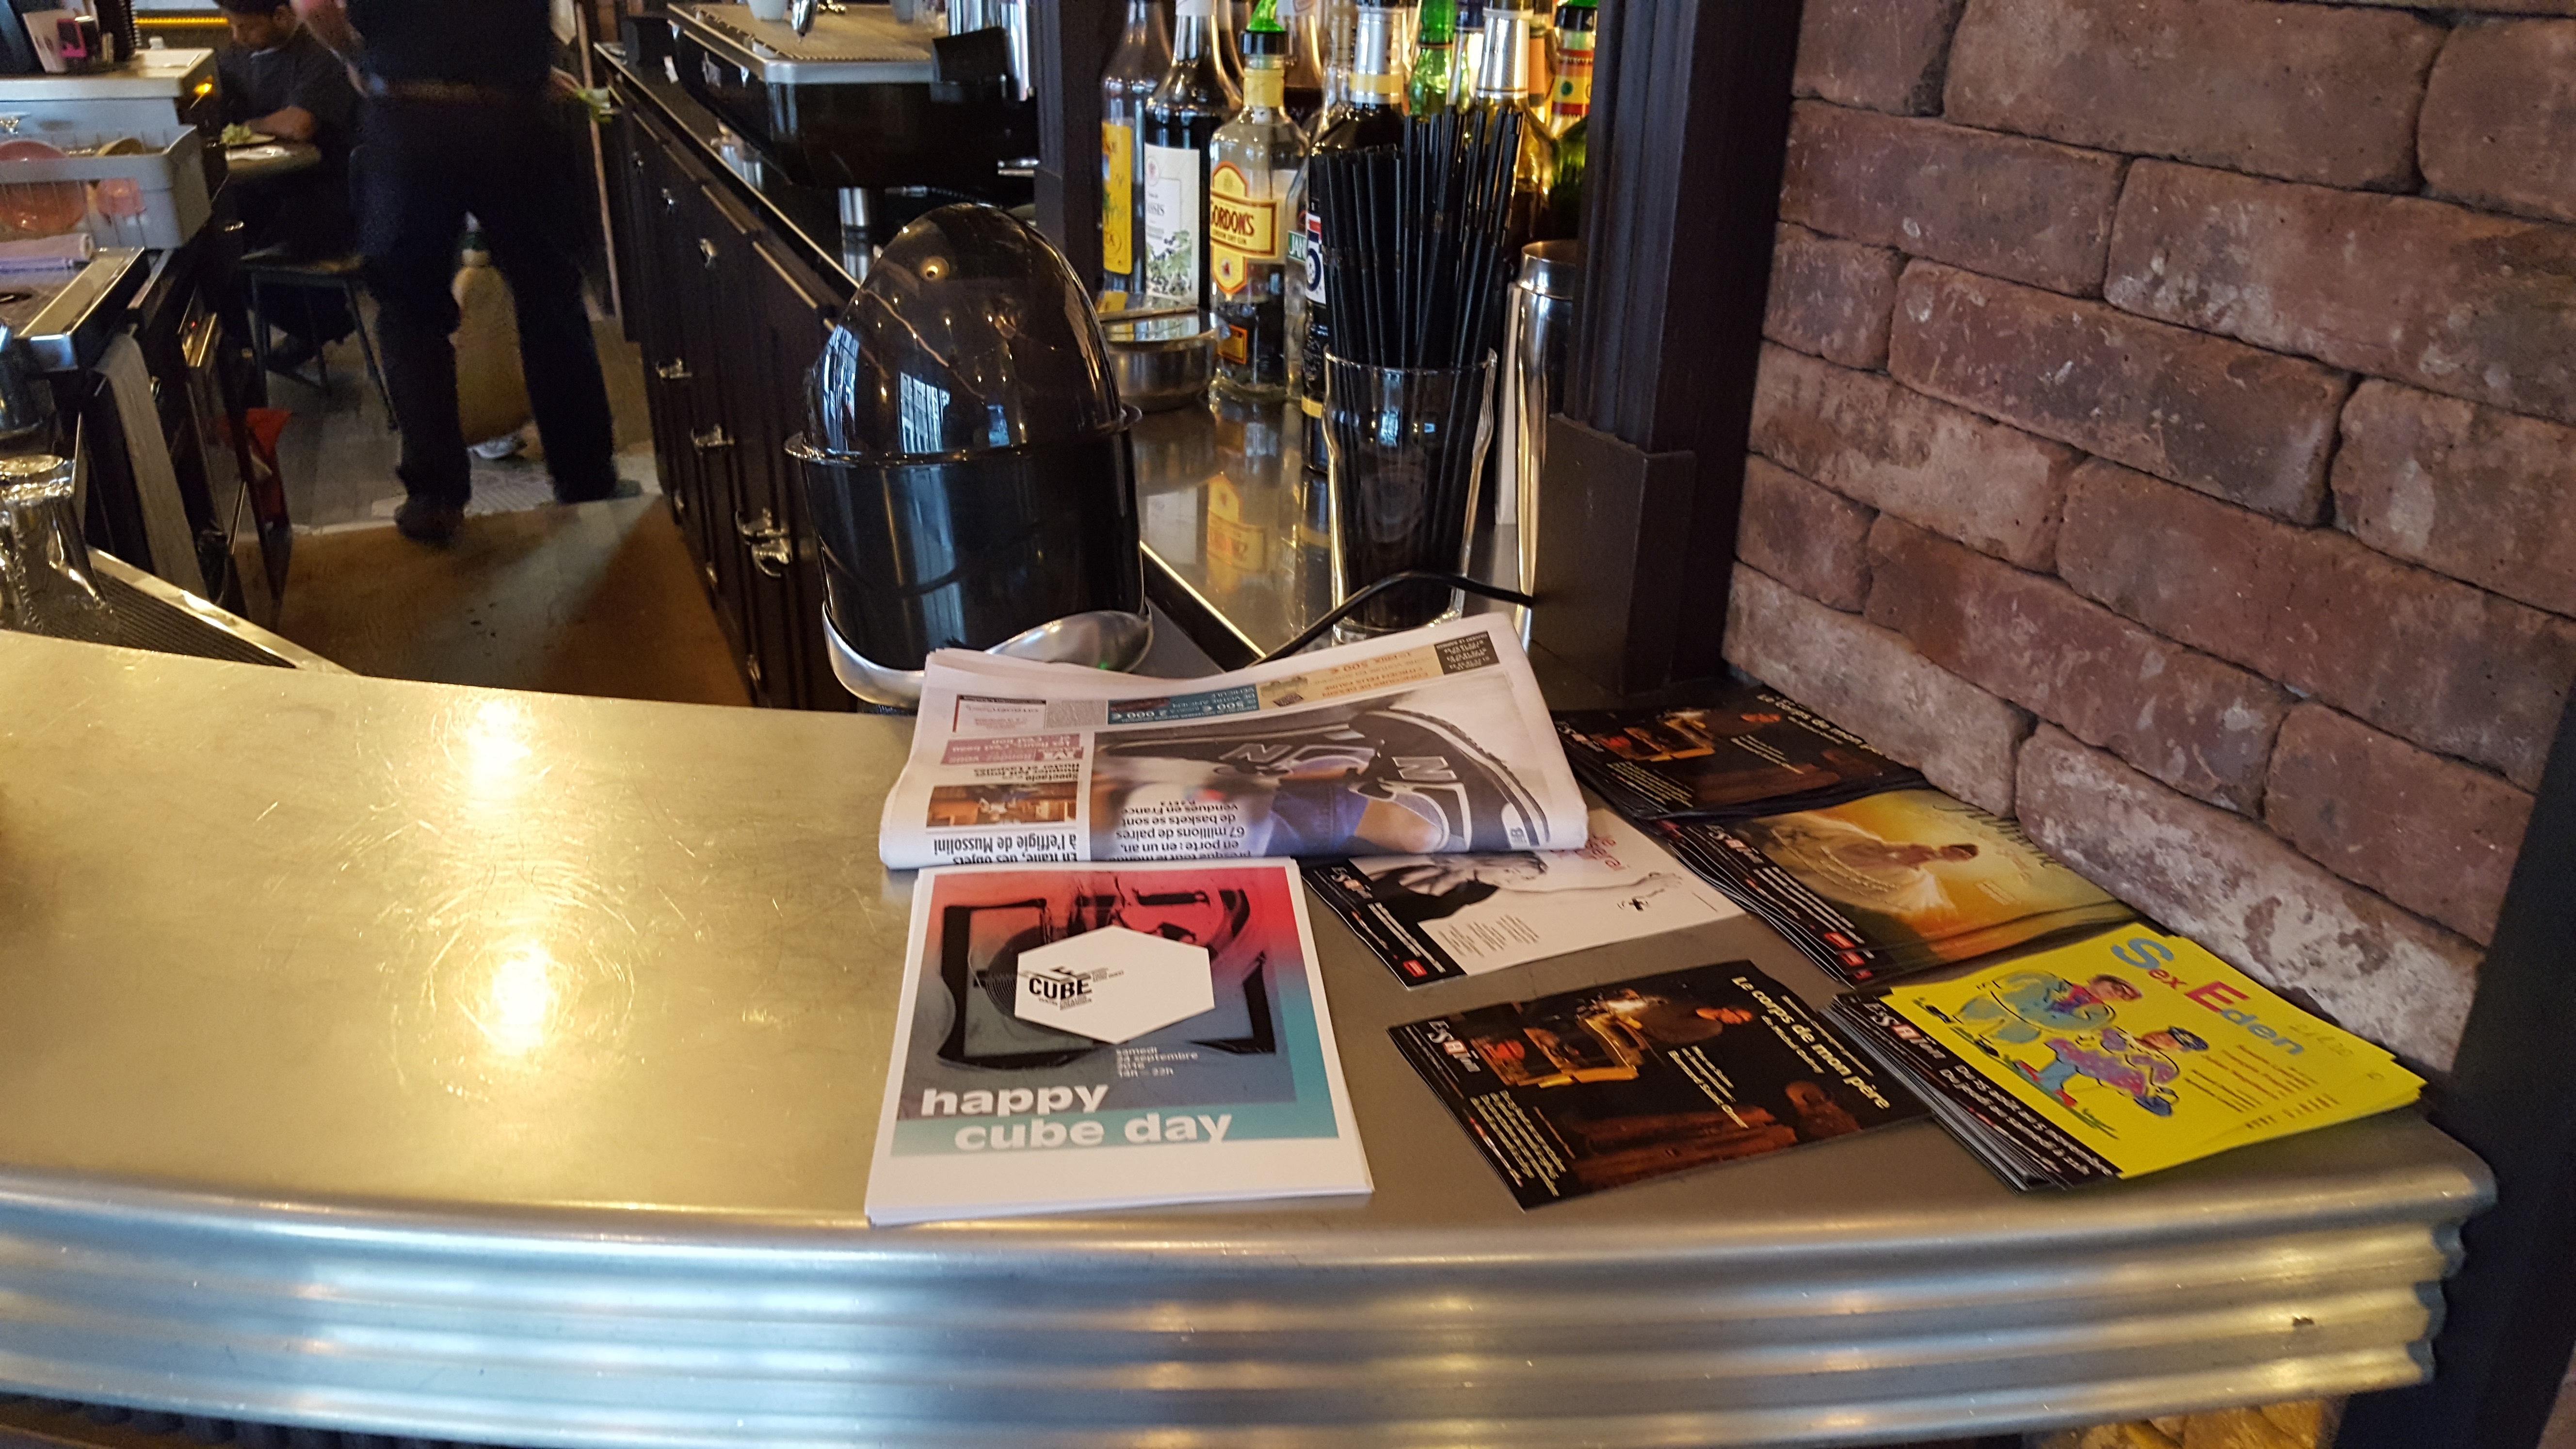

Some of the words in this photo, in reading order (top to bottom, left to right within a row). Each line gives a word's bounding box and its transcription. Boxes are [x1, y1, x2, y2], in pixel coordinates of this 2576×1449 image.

[1121, 817, 1150, 827] sont
[1169, 814, 1217, 825] baskets
[1220, 814, 1236, 824] de
[1116, 828, 1155, 841] paires
[1158, 829, 1174, 840] de
[1176, 827, 1226, 839] millions
[1230, 826, 1245, 838] 67
[934, 837, 993, 856] Mussolini
[997, 837, 1013, 853] de
[1143, 843, 1159, 853] un
[1161, 843, 1177, 852] en
[1224, 841, 1239, 850] en
[1029, 977, 1093, 1000] CUBE
[1732, 976, 1755, 991] Le
[1752, 990, 1795, 1024] corps
[1791, 1024, 1815, 1043] de
[1811, 1044, 1852, 1076] mon
[1843, 1076, 1890, 1109] père
[1116, 1046, 1158, 1056] samedi
[1134, 1051, 1198, 1063] septembre
[1939, 1069, 1961, 1084] Du
[1954, 1064, 1976, 1080] Du
[921, 1083, 1109, 1118] happy
[954, 1117, 1104, 1152] cube
[1124, 1112, 1232, 1144] day
